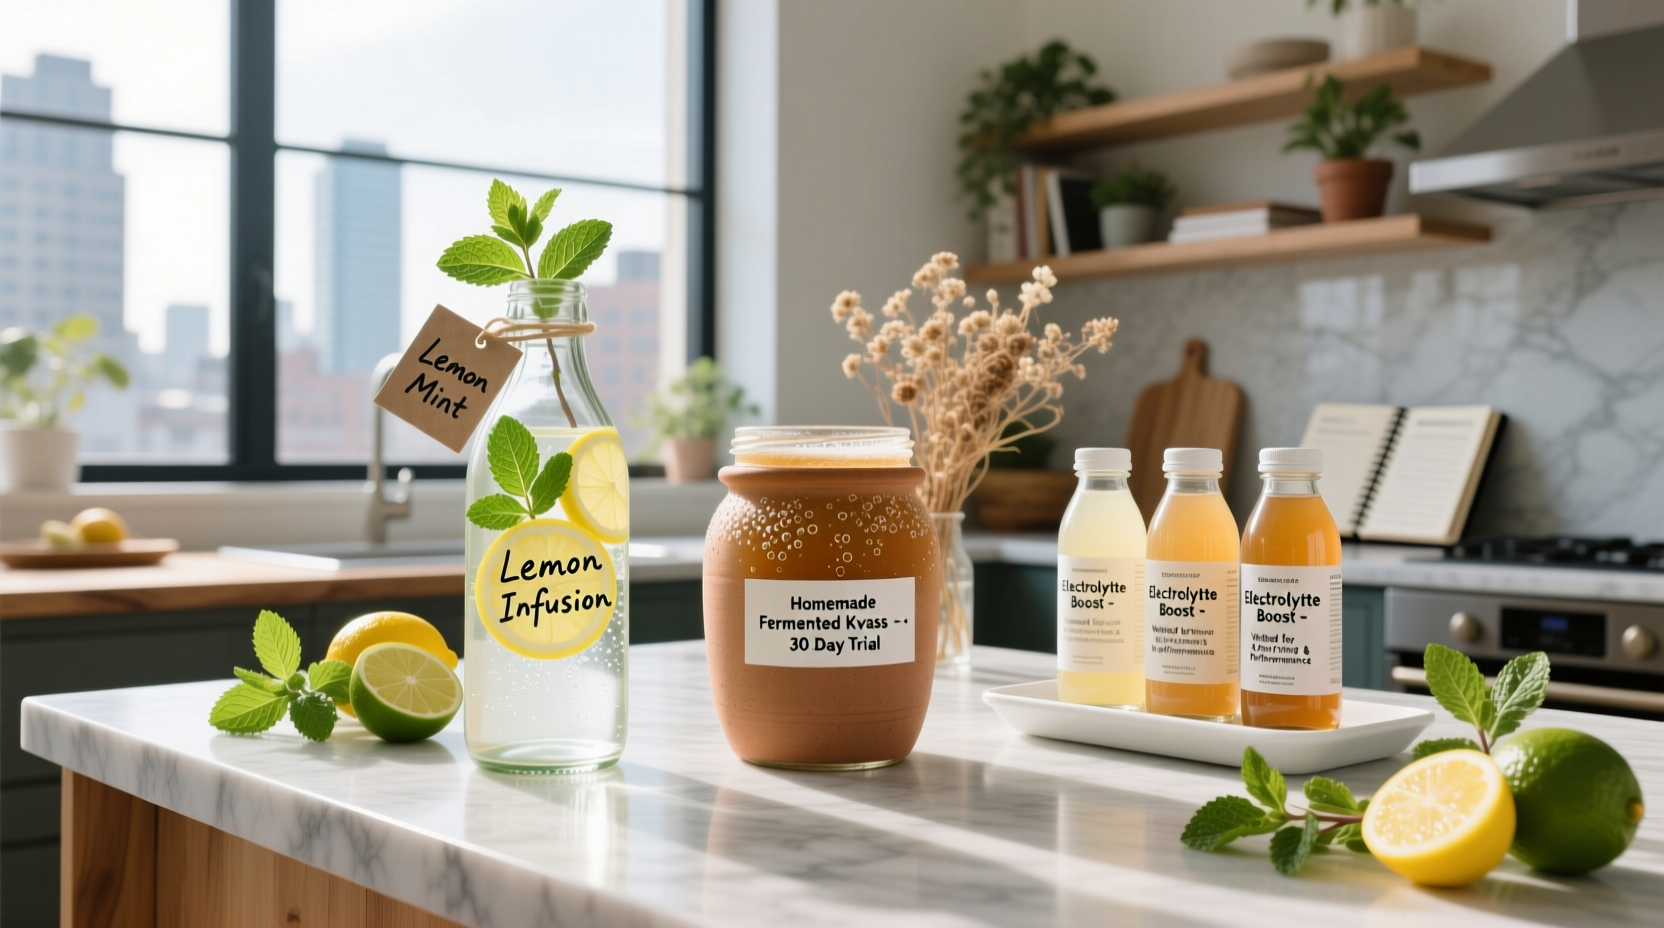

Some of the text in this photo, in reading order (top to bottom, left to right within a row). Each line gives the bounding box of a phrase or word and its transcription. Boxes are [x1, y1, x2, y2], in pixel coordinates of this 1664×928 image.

[418, 337, 488, 394] Lemon
[404, 373, 468, 419] Mint
[500, 549, 603, 583] Lemon
[499, 587, 612, 628] Infusion
[790, 594, 876, 610] Homemade
[1071, 595, 1104, 609] Boost
[1159, 603, 1195, 617] Boost
[759, 615, 841, 630] Fermented
[846, 615, 888, 630] Kvass
[1257, 608, 1296, 623] Boost
[789, 635, 880, 656] 30 Day Trial
